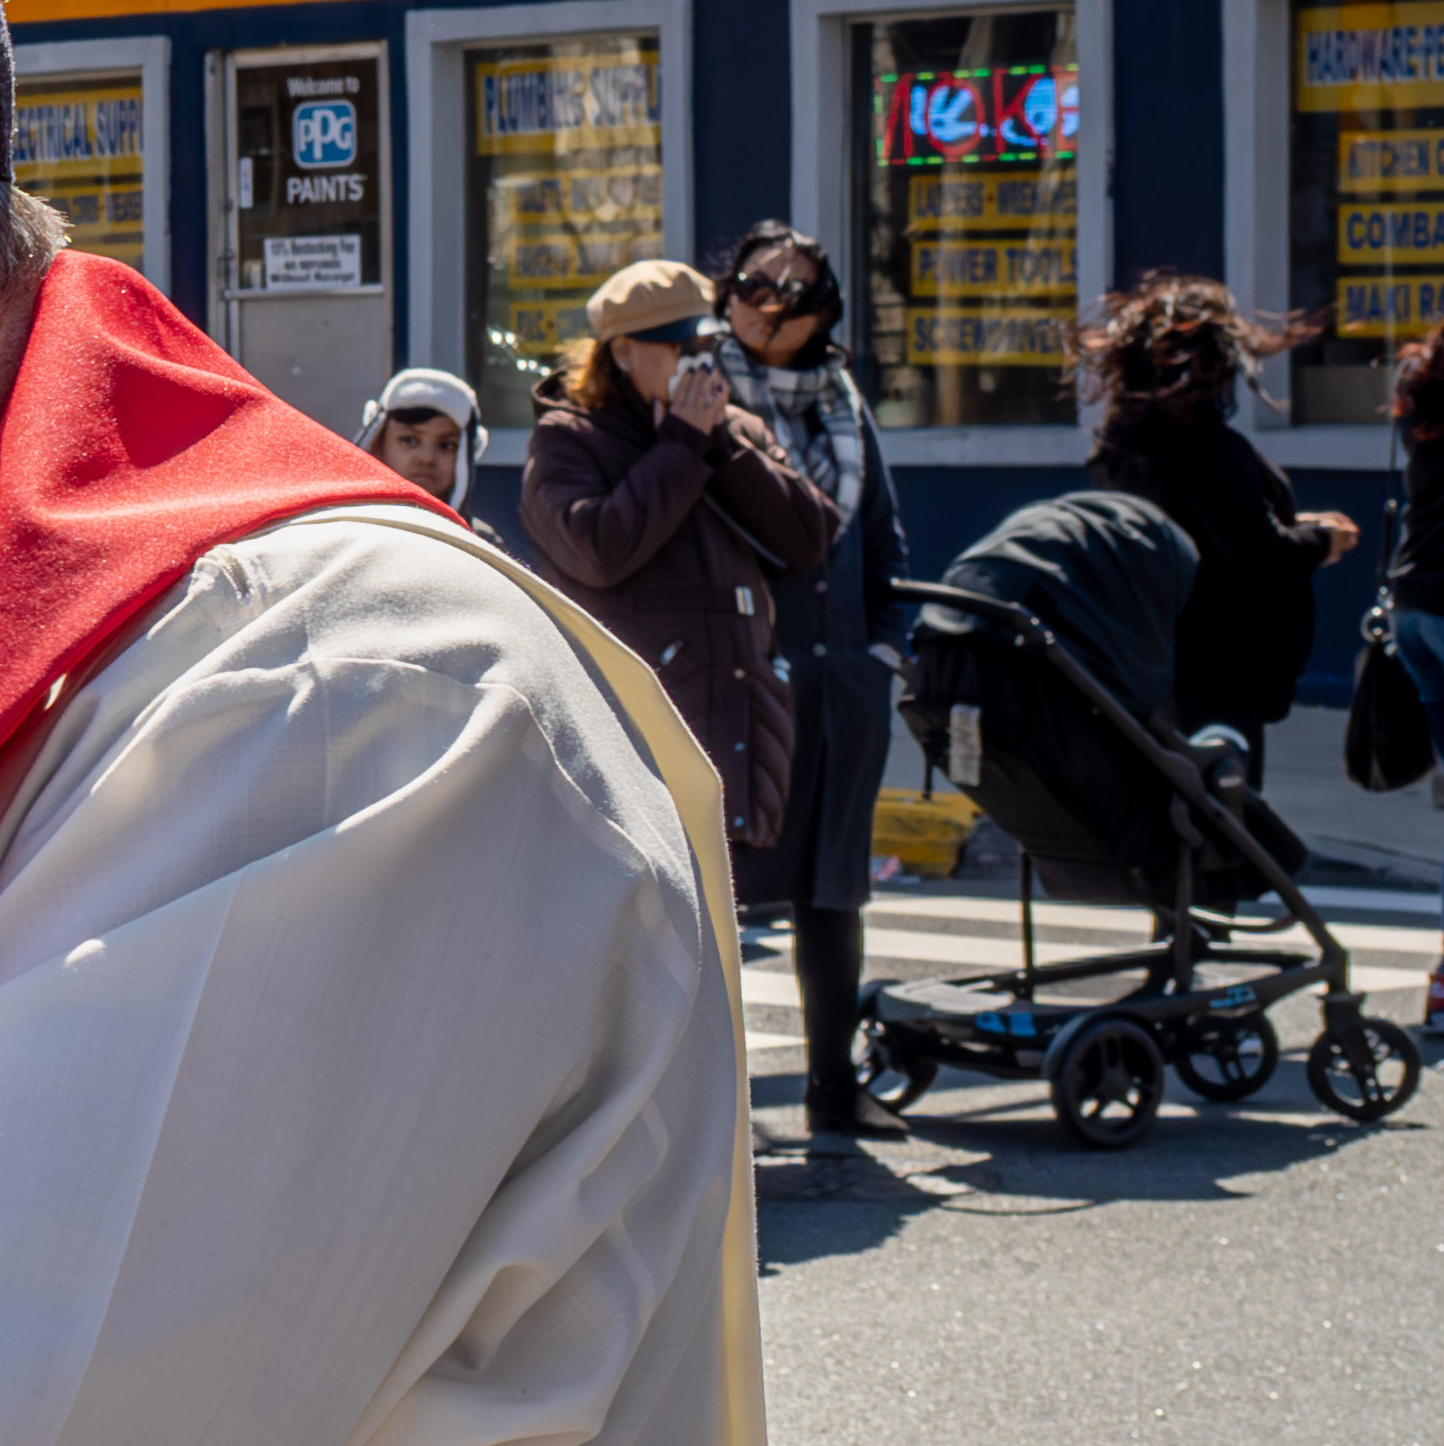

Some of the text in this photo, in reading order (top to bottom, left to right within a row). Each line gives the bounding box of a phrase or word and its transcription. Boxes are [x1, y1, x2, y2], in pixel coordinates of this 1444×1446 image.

[286, 75, 343, 98] Welcome
[299, 109, 352, 160] PPG
[286, 173, 365, 204] PAINTS
